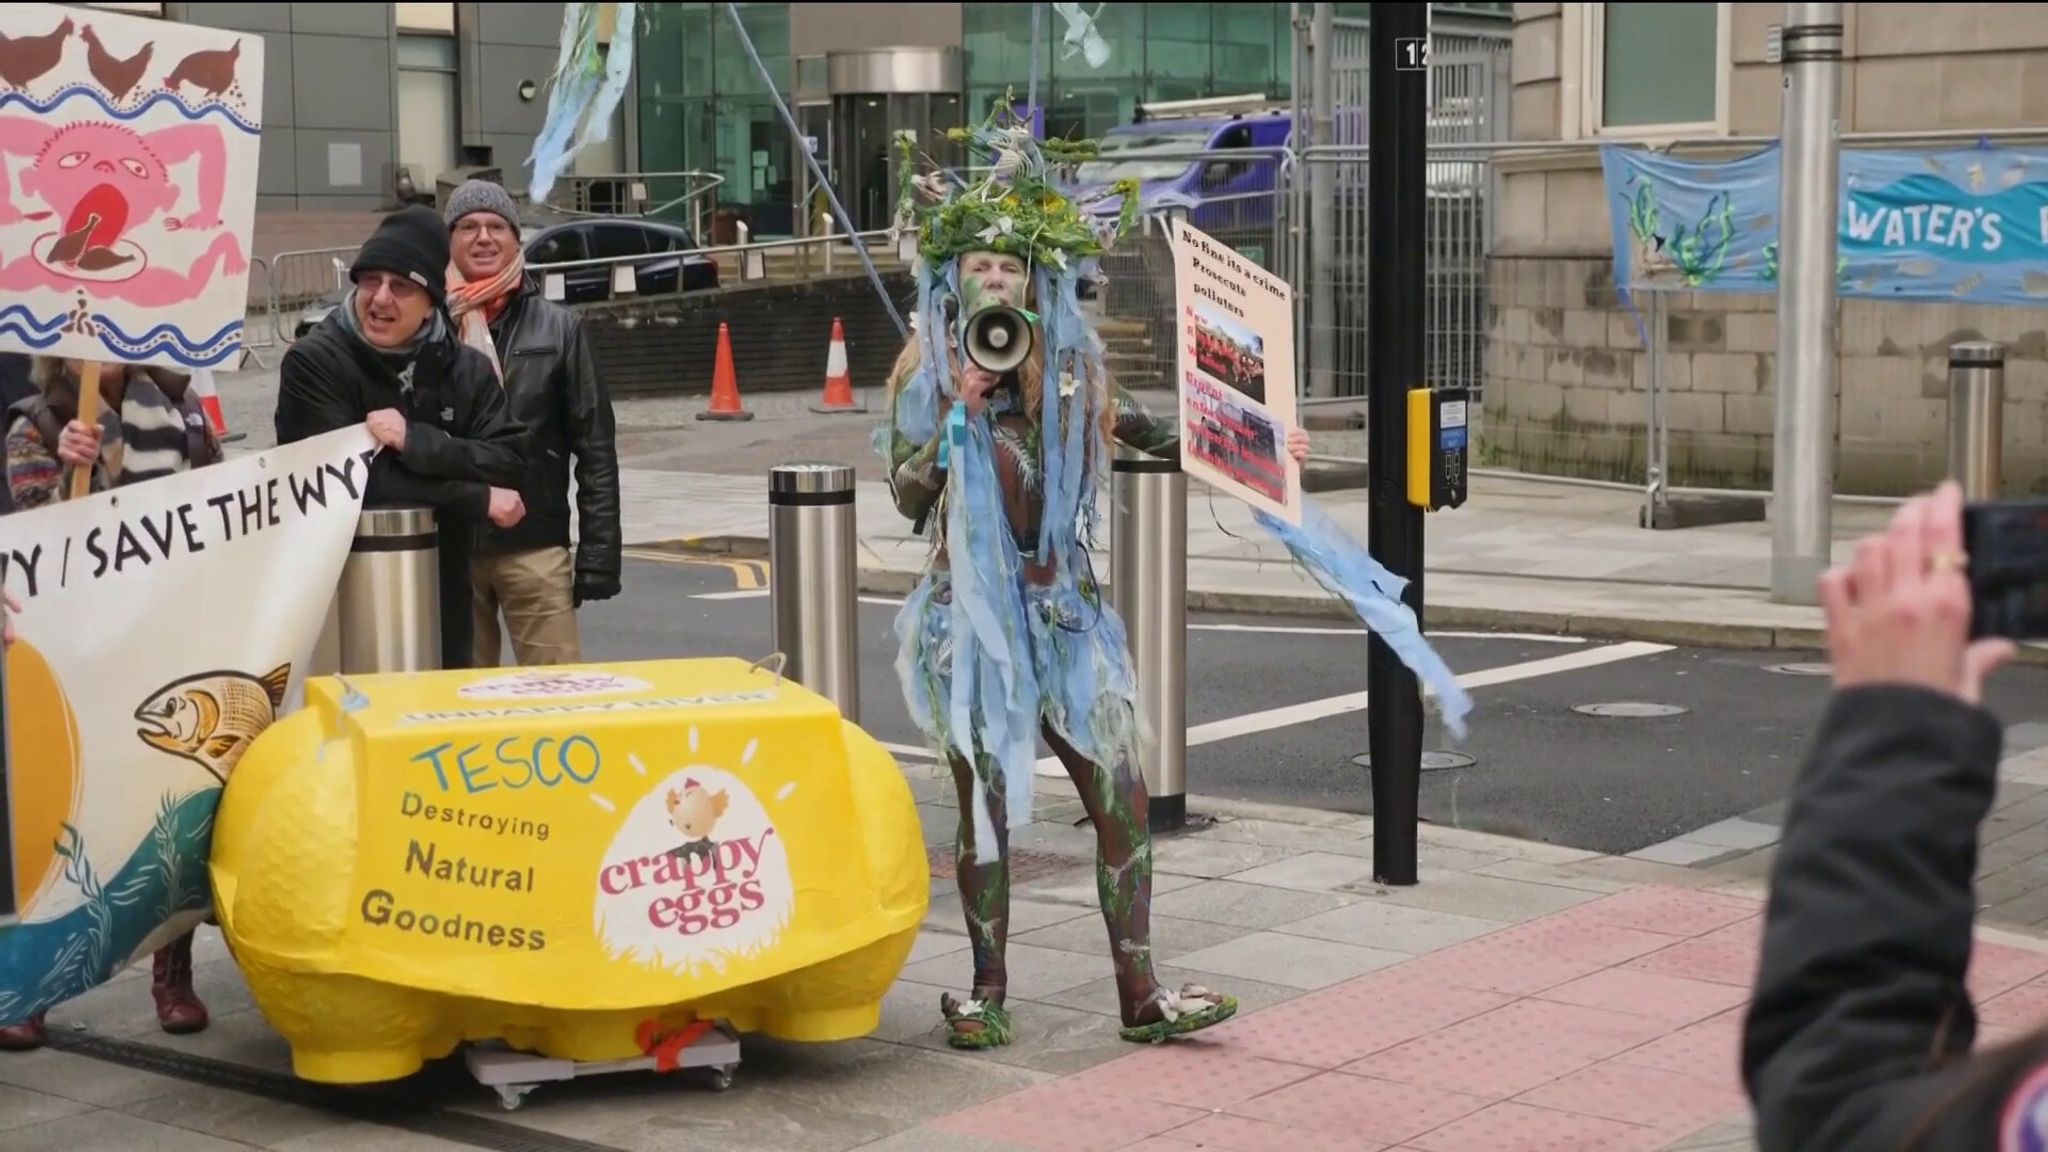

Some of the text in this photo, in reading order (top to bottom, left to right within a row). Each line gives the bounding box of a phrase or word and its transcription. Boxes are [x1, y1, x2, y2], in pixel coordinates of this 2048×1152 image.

[1847, 200, 2003, 251] WATER'S
[1182, 230, 1287, 301] No fine its a crime
[1192, 256, 1247, 298] Prosecute
[1193, 283, 1245, 318] polluters
[0, 543, 42, 597] Y
[87, 501, 206, 579] SAVE
[207, 476, 281, 542] THE
[405, 693, 770, 721] UNHAPPY RIVER
[410, 733, 601, 796] TESCO
[400, 791, 551, 842] Destroying
[404, 838, 535, 893] Natural
[599, 827, 775, 897] crappy
[360, 888, 546, 952] Goodness
[647, 876, 766, 936] eggs
